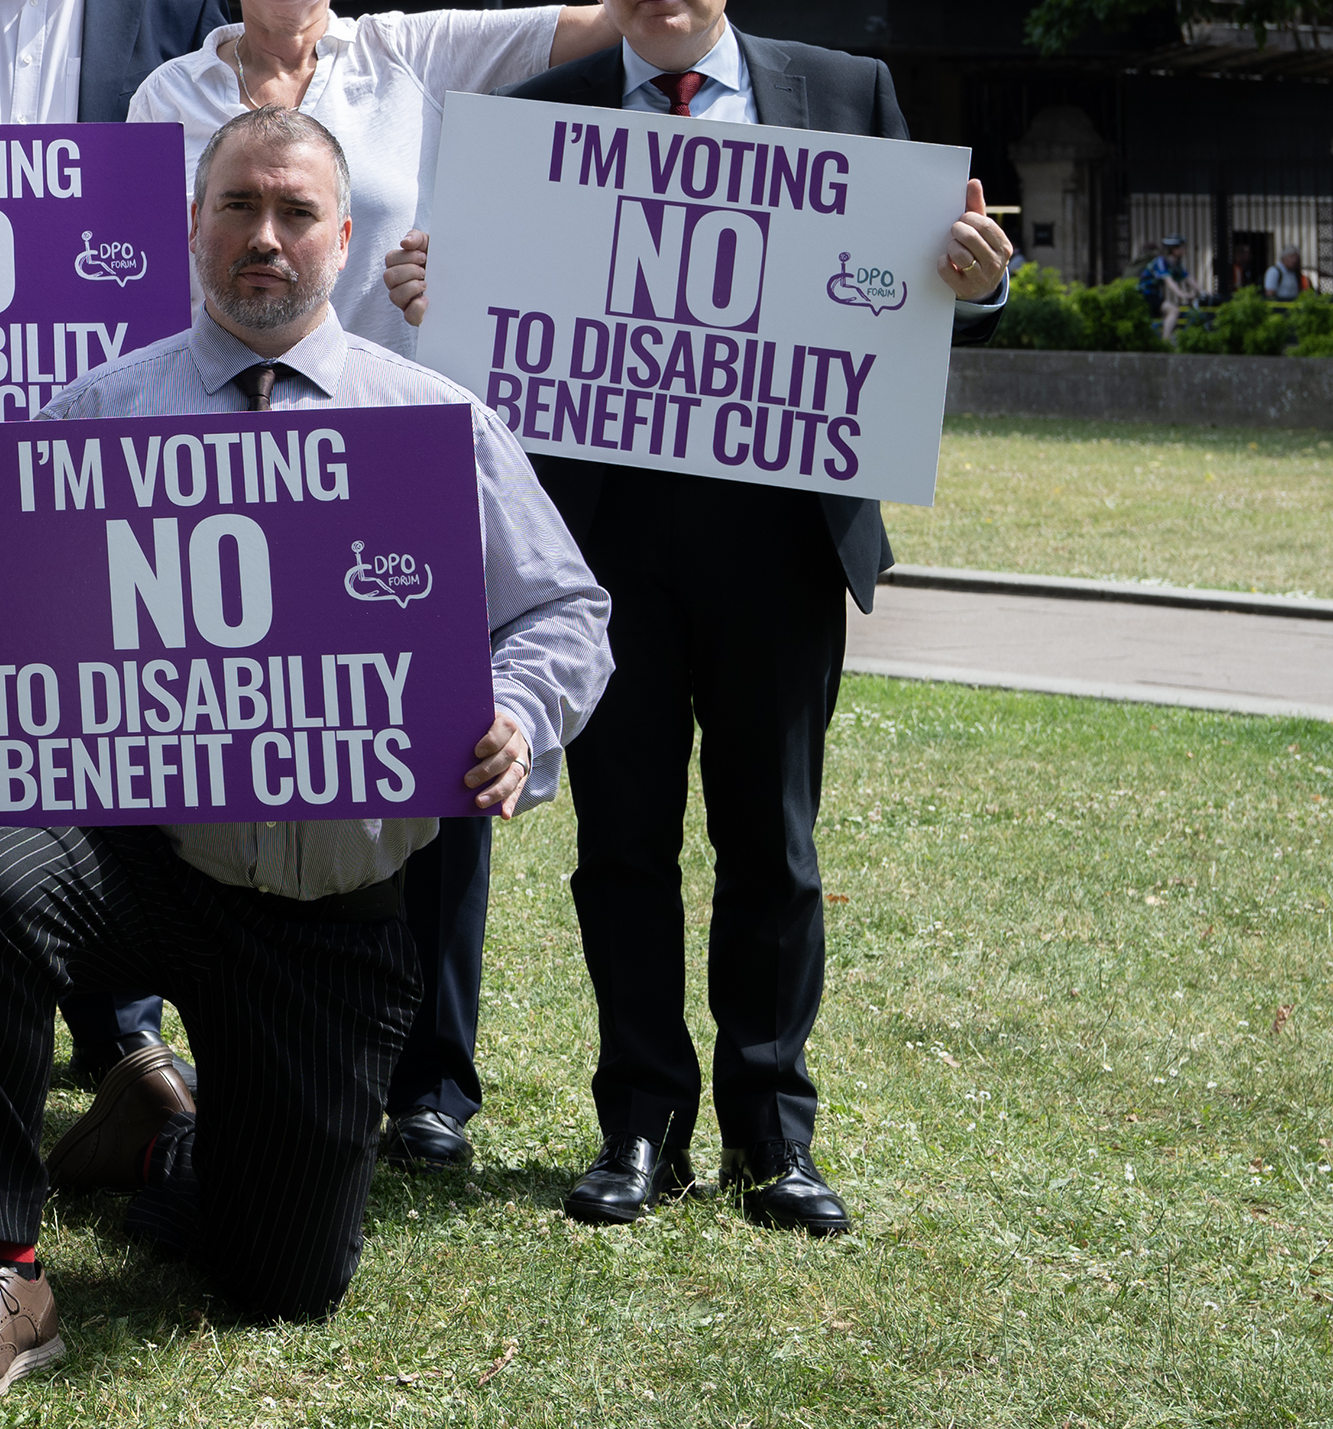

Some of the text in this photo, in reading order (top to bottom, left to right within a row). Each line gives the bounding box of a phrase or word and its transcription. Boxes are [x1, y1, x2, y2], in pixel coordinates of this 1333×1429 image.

[548, 120, 849, 215] I'M VOTING
[100, 243, 133, 259] DPO
[111, 259, 137, 269] FORUM
[608, 200, 764, 327] NO
[857, 268, 894, 287] DPO
[867, 287, 895, 298] FORUM
[488, 306, 877, 416] TO DISABILITY
[486, 371, 861, 481] BENEFIT CUTS
[17, 428, 349, 512] I'M VOTING
[106, 514, 273, 650] NO
[374, 554, 415, 574] DPO
[388, 575, 420, 587] FORUM
[78, 652, 412, 734] DISABILITY
[250, 728, 415, 806] CUTS
